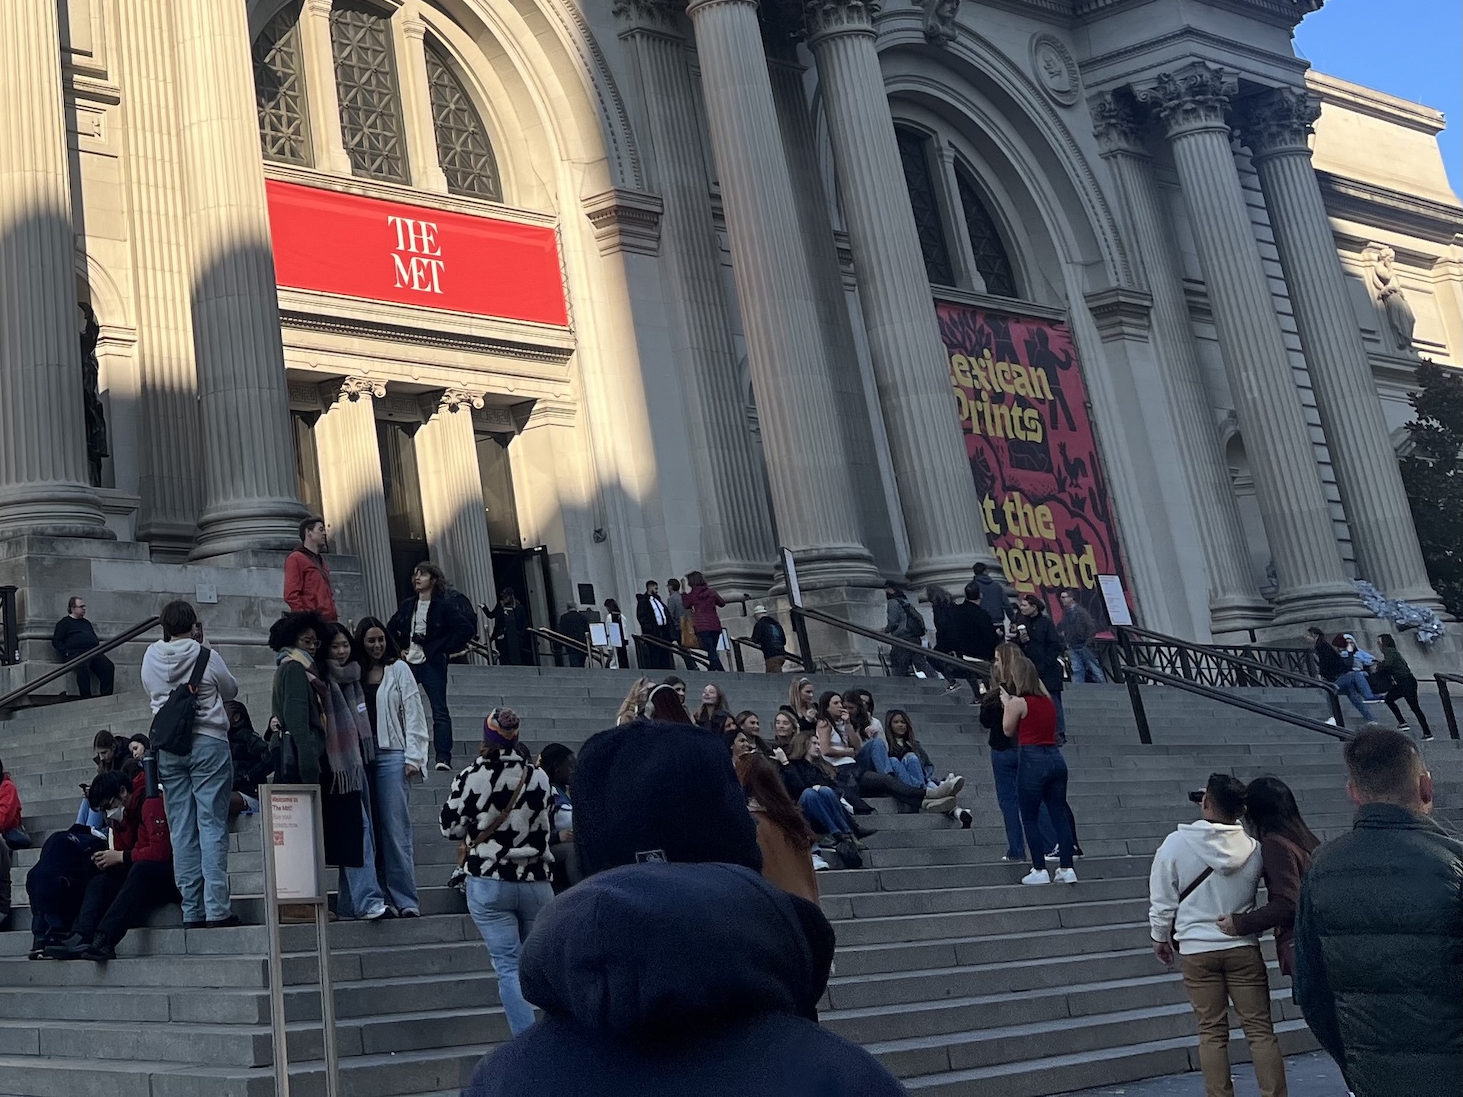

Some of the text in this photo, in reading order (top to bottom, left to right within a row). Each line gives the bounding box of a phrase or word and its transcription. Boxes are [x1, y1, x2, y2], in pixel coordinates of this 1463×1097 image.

[387, 215, 442, 257] THE
[389, 252, 446, 295] MET
[942, 344, 1054, 401] exican
[1002, 491, 1057, 540] the
[988, 538, 1098, 593] nguard
